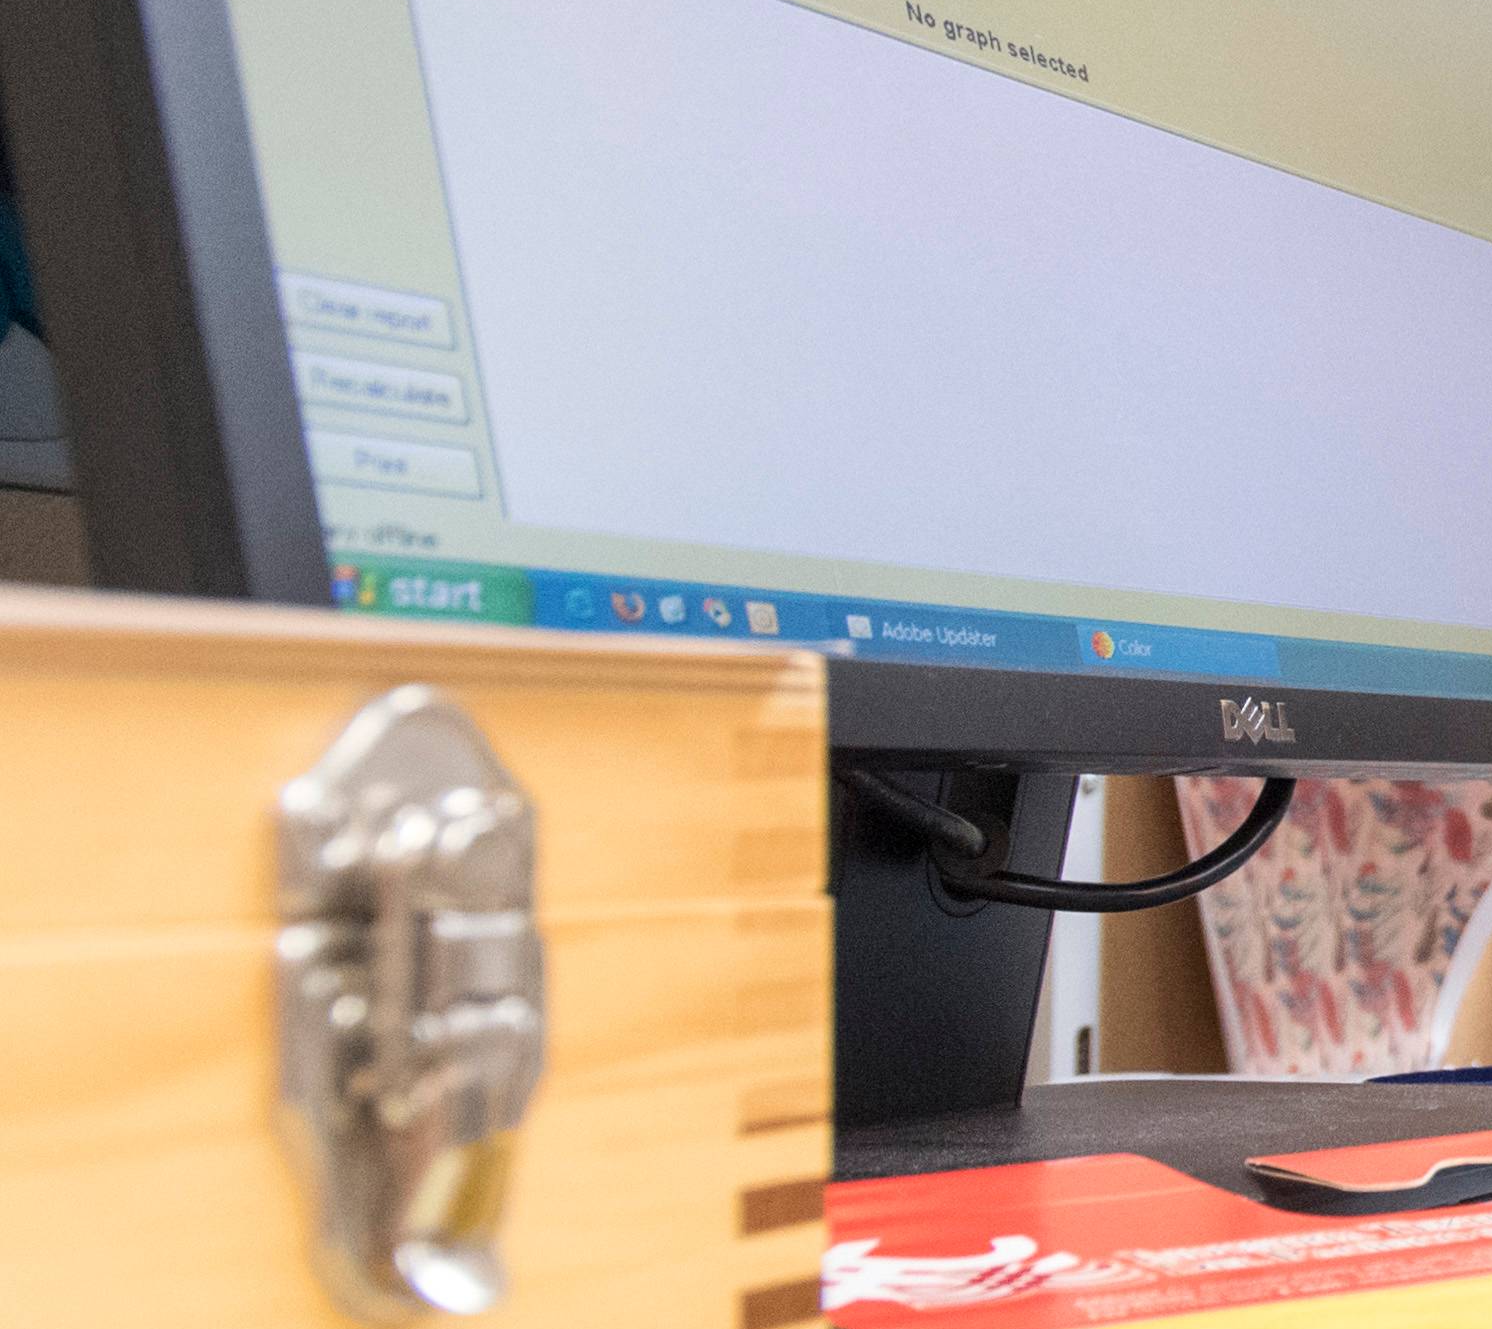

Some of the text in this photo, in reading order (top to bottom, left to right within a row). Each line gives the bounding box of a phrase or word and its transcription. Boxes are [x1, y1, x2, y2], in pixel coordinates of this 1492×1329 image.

[905, 0, 1090, 83] No graph selected
[389, 576, 482, 613] start
[881, 621, 998, 649] Adobe Updater
[1118, 636, 1153, 658] Color
[1220, 696, 1296, 746] DELL
